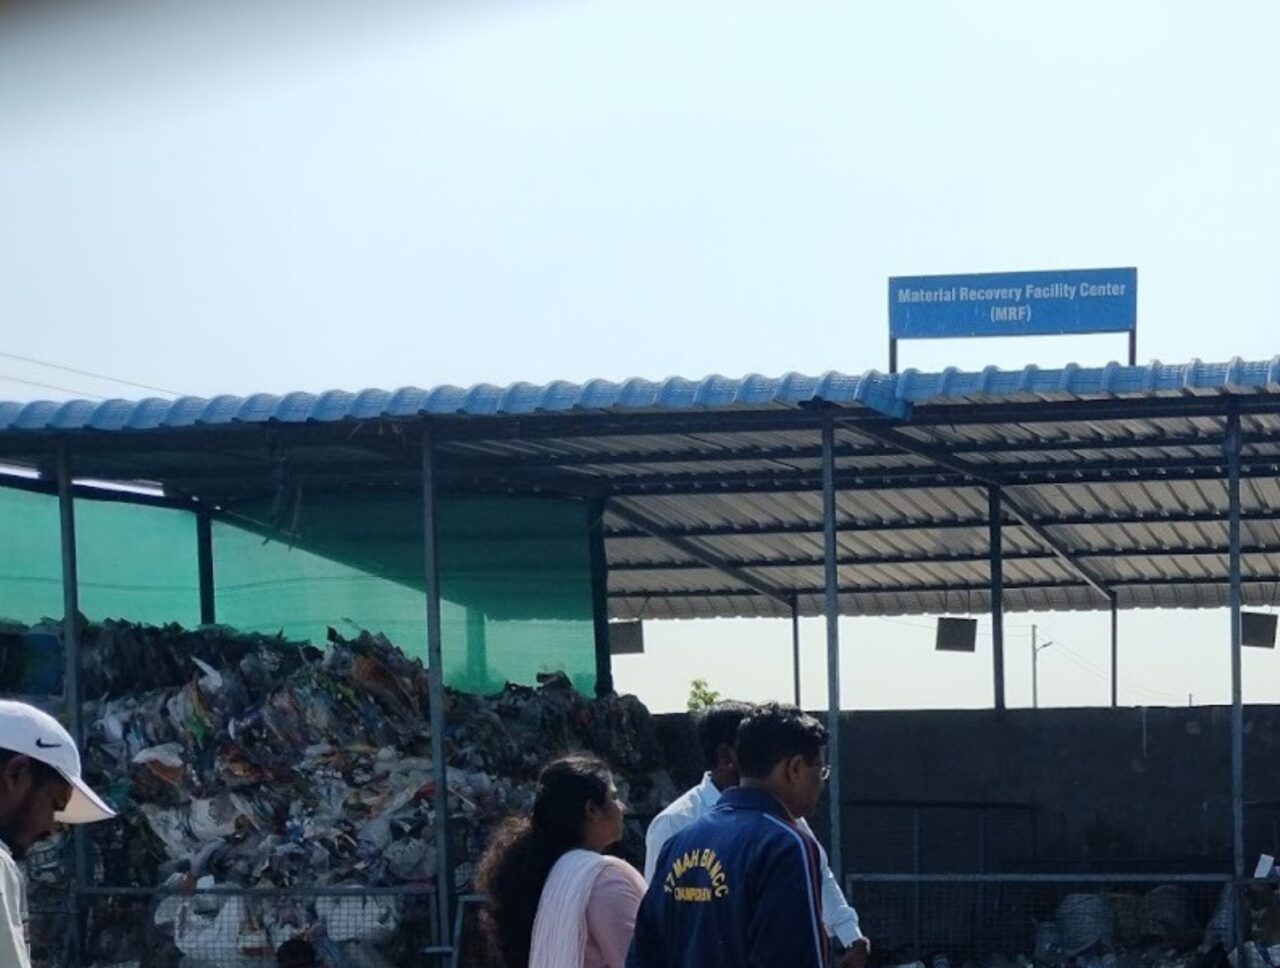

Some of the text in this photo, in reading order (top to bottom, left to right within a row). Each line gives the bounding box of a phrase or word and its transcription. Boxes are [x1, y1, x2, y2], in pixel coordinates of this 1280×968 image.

[898, 282, 1126, 303] Material Recovery Facility Center
[990, 305, 1032, 322] (MRF)
